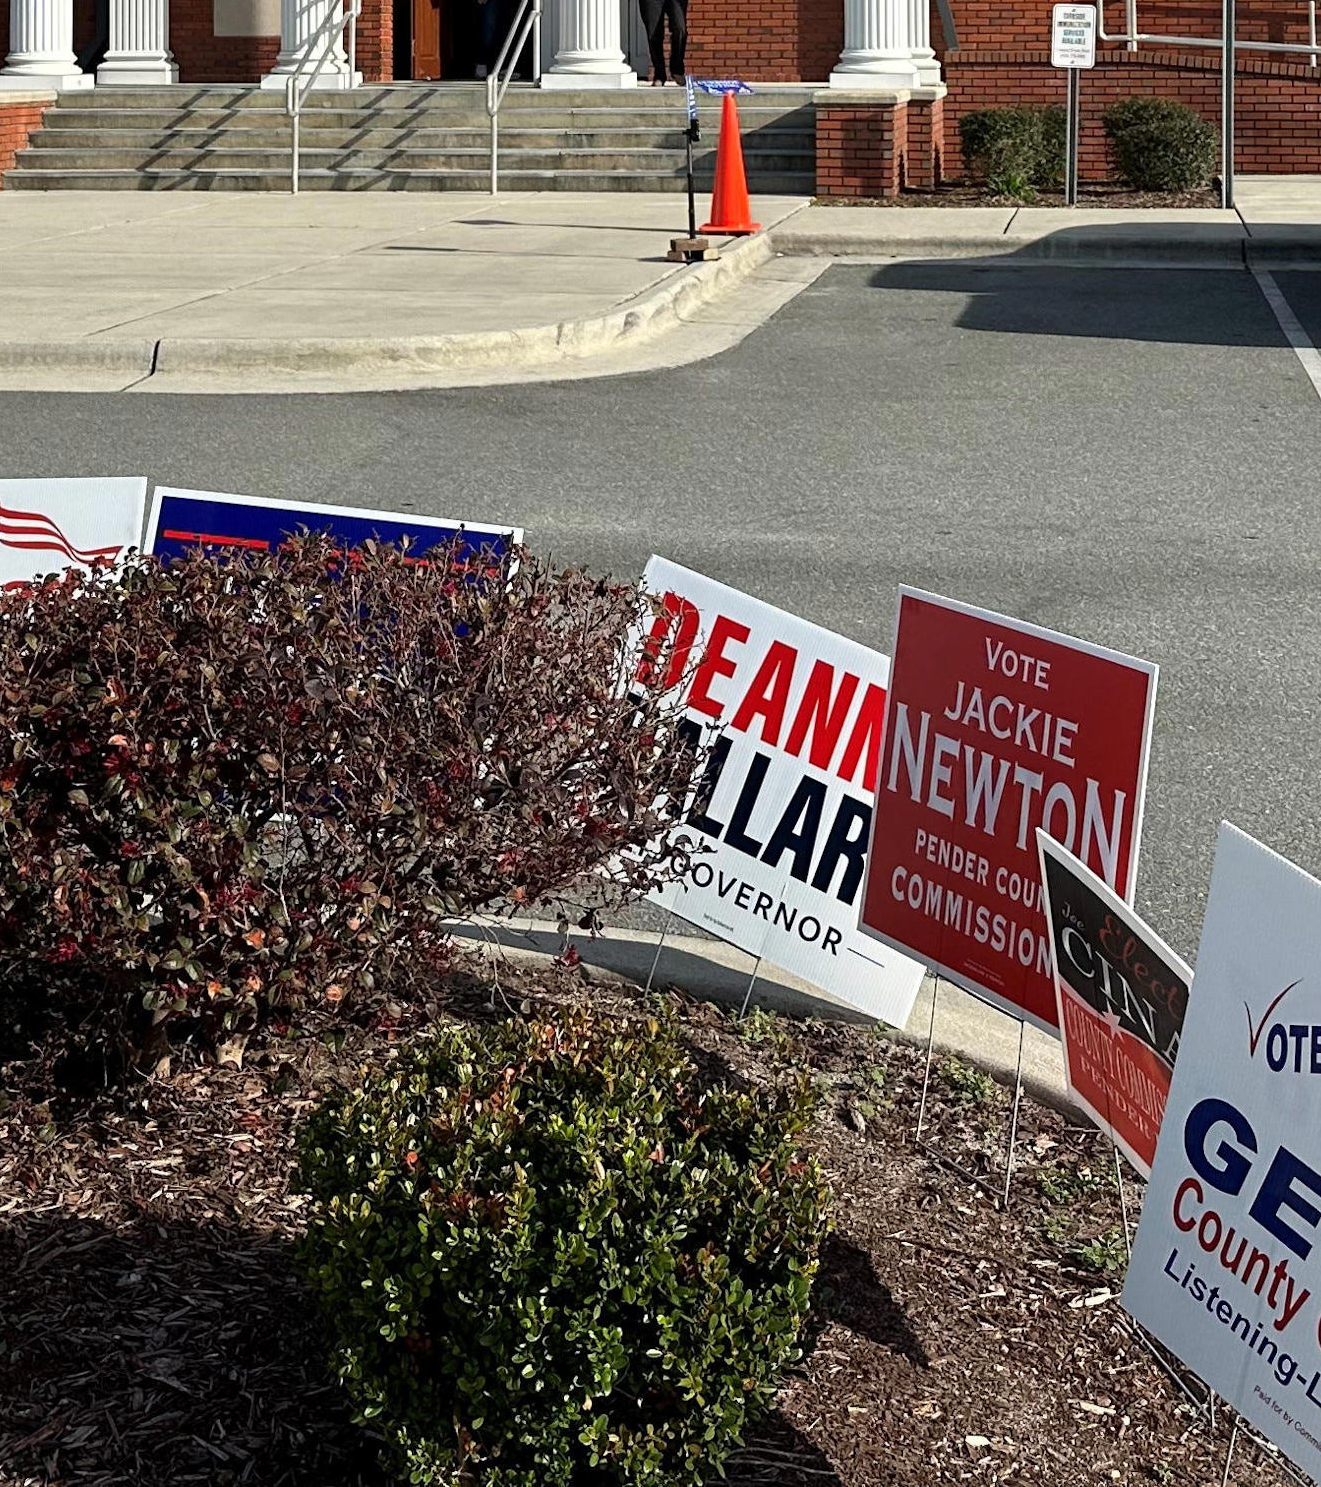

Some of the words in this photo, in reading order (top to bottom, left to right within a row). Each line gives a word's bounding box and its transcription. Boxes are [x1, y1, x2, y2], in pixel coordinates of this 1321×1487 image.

[984, 636, 1052, 691] VOTE
[944, 680, 1080, 769] JACKIE
[886, 701, 1127, 891] NEWTON
[915, 828, 990, 887] PENDER
[1065, 998, 1116, 1080] COUNTY
[1080, 1055, 1152, 1140] PENDER
[1173, 1177, 1311, 1332] County
[1253, 1384, 1271, 1405] Paid
[1283, 1411, 1294, 1426] by
